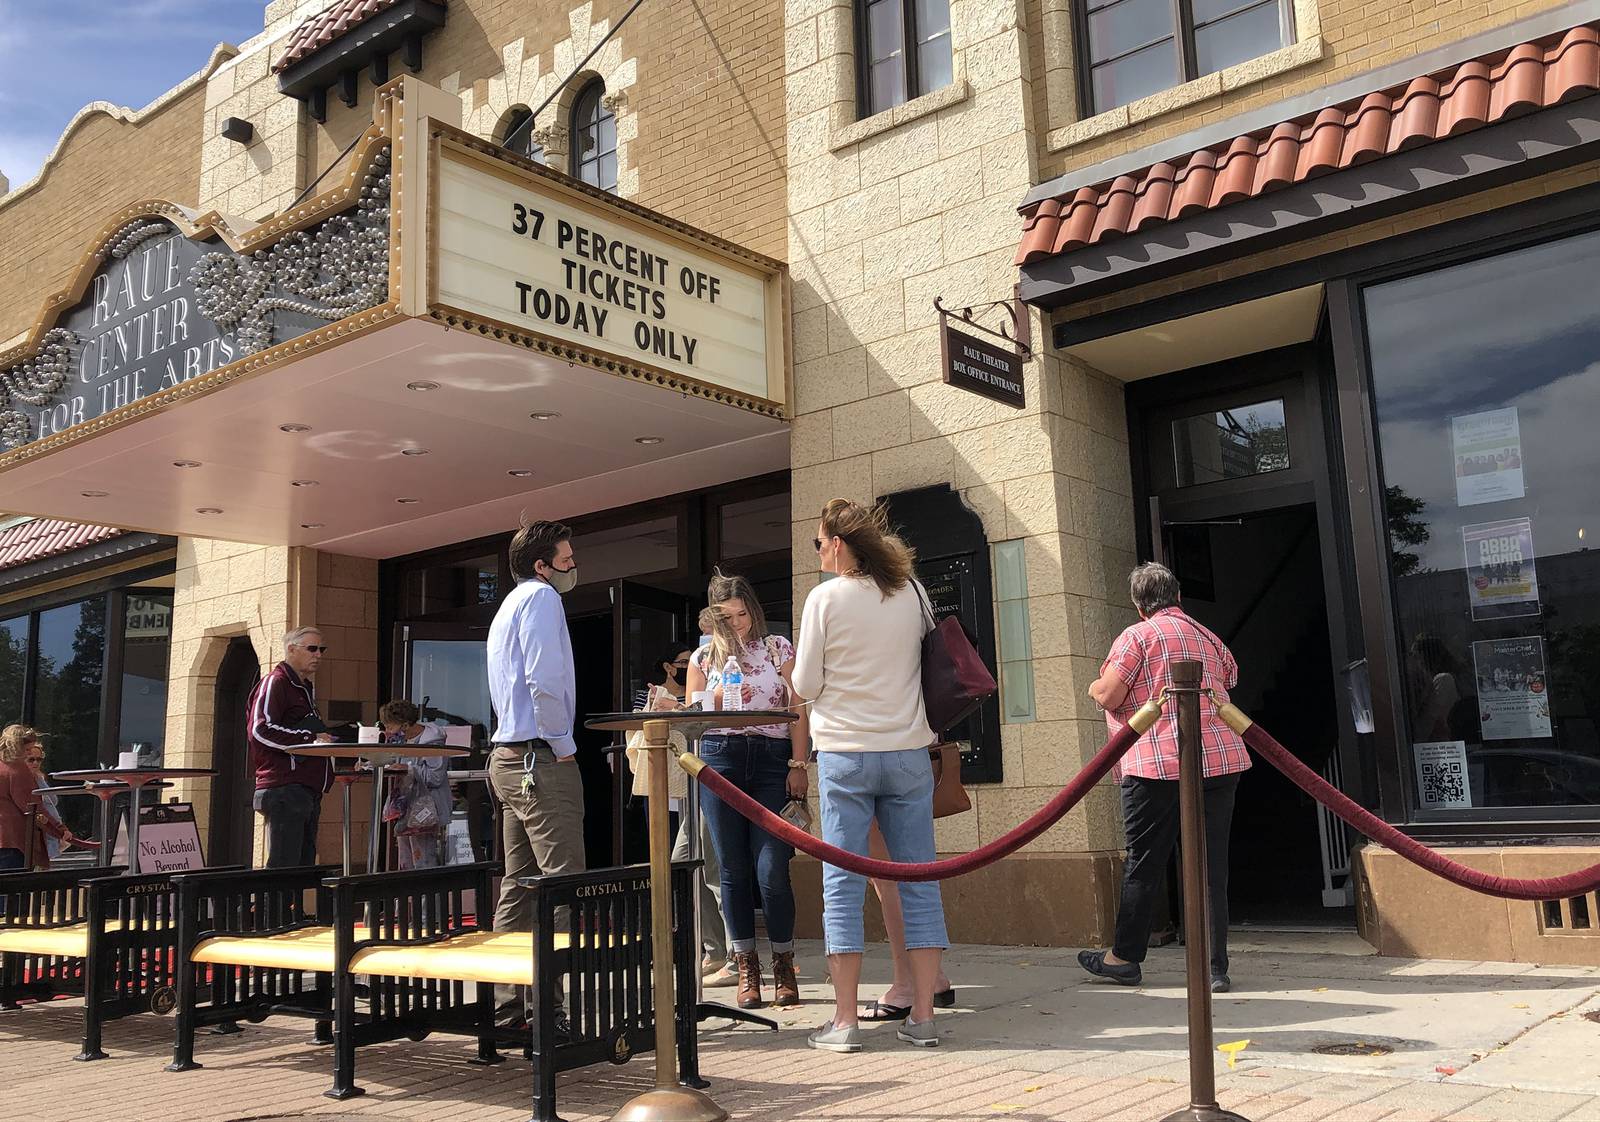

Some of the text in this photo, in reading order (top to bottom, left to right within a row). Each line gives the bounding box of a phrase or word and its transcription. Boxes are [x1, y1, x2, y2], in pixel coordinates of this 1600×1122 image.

[513, 203, 721, 304] 37 PERCENT OFF
[89, 234, 185, 331] RAUE
[562, 258, 666, 320] TICKETS
[79, 296, 189, 385] CENTER
[515, 281, 697, 365] TODAY ONLY
[963, 345, 1010, 372] RAUE THEATER
[38, 331, 234, 440] FOR THE ARTS
[953, 360, 1022, 395] BOX OFFICE ENTRANCE
[1479, 535, 1520, 554] ABBA
[140, 838, 196, 857] No Alcohol
[154, 857, 190, 873] Beyond
[126, 882, 172, 894] CRYSTAL
[576, 878, 652, 898] CRYSTAL LAK
